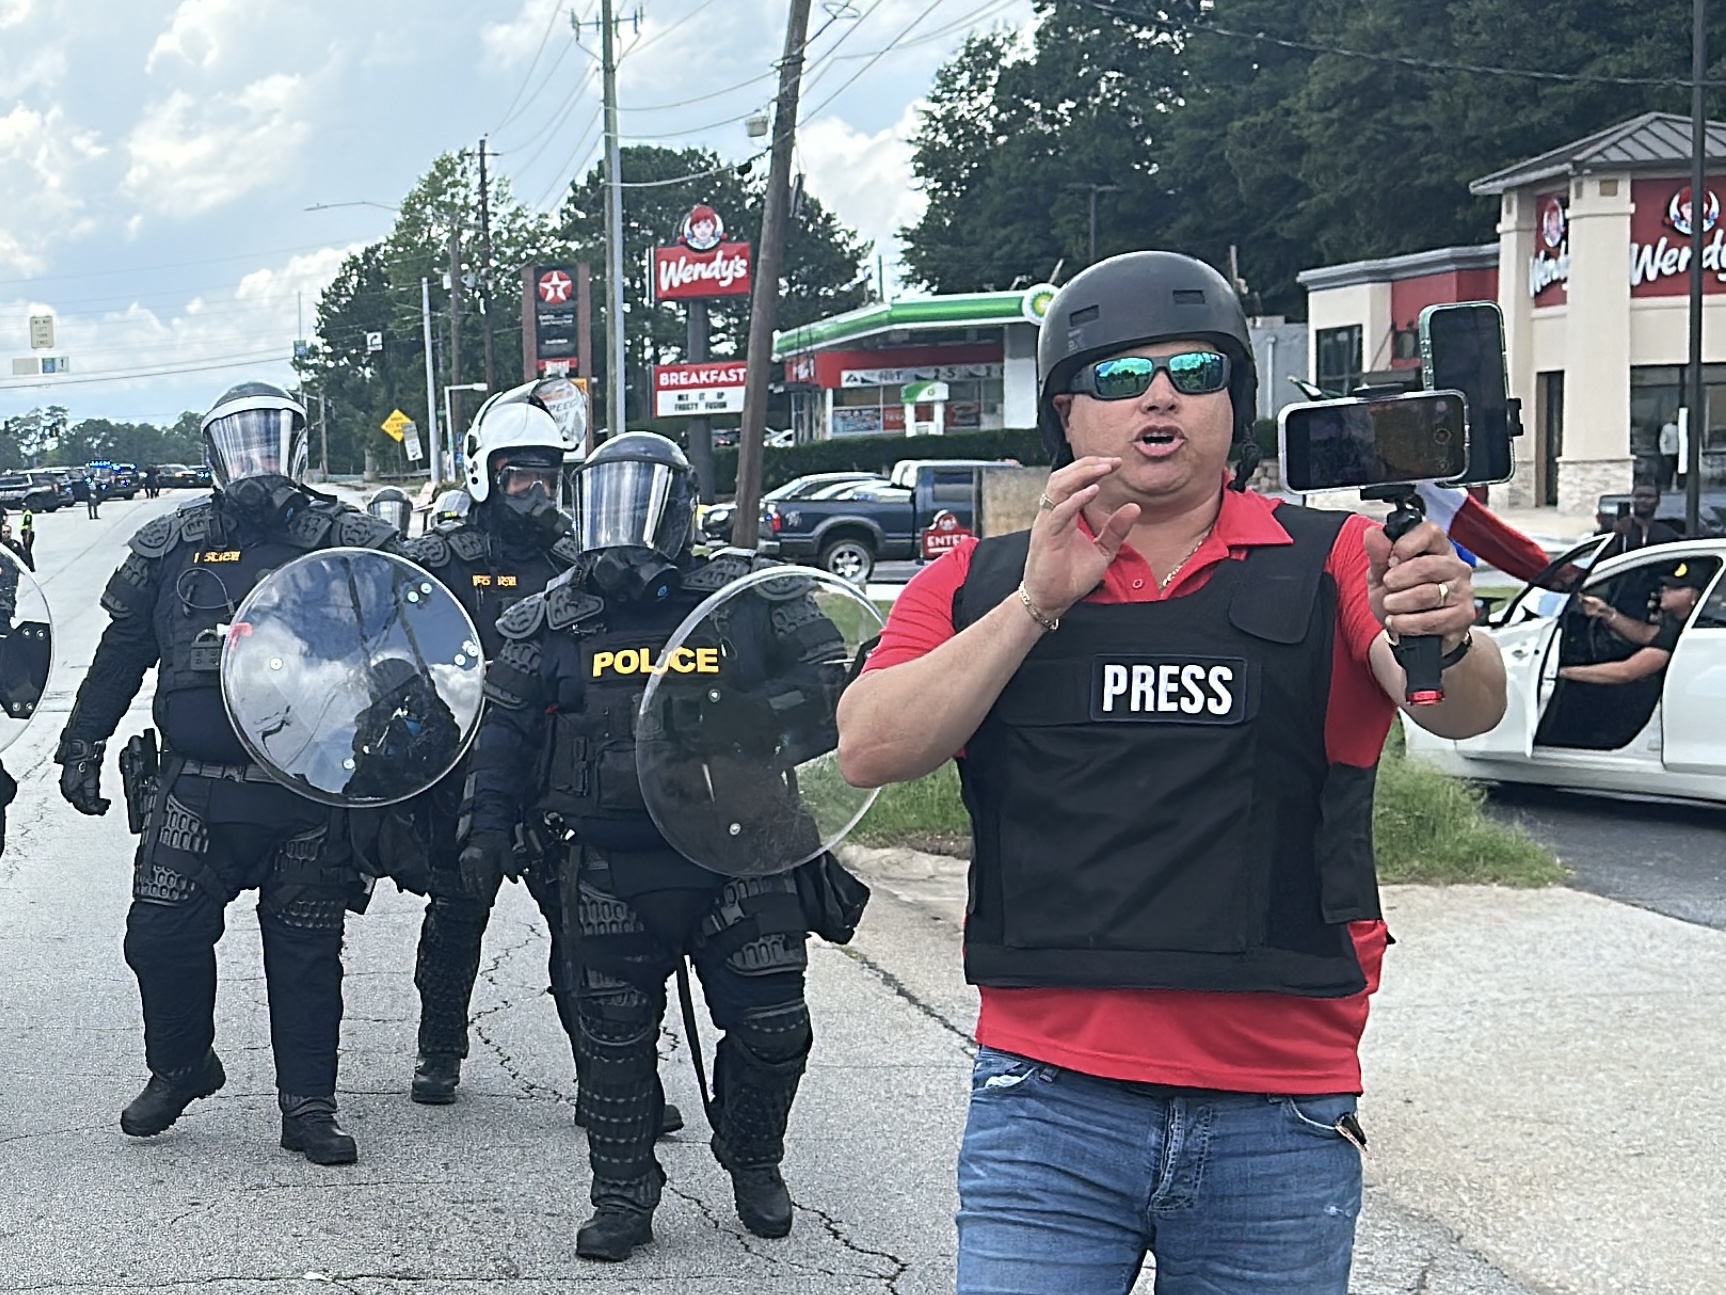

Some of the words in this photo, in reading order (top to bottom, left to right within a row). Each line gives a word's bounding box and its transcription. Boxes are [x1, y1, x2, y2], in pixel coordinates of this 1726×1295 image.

[660, 250, 748, 291] Wendy's
[660, 368, 747, 386] BREAKFAST
[472, 574, 518, 587] POICE
[1102, 664, 1234, 715] PRESS
